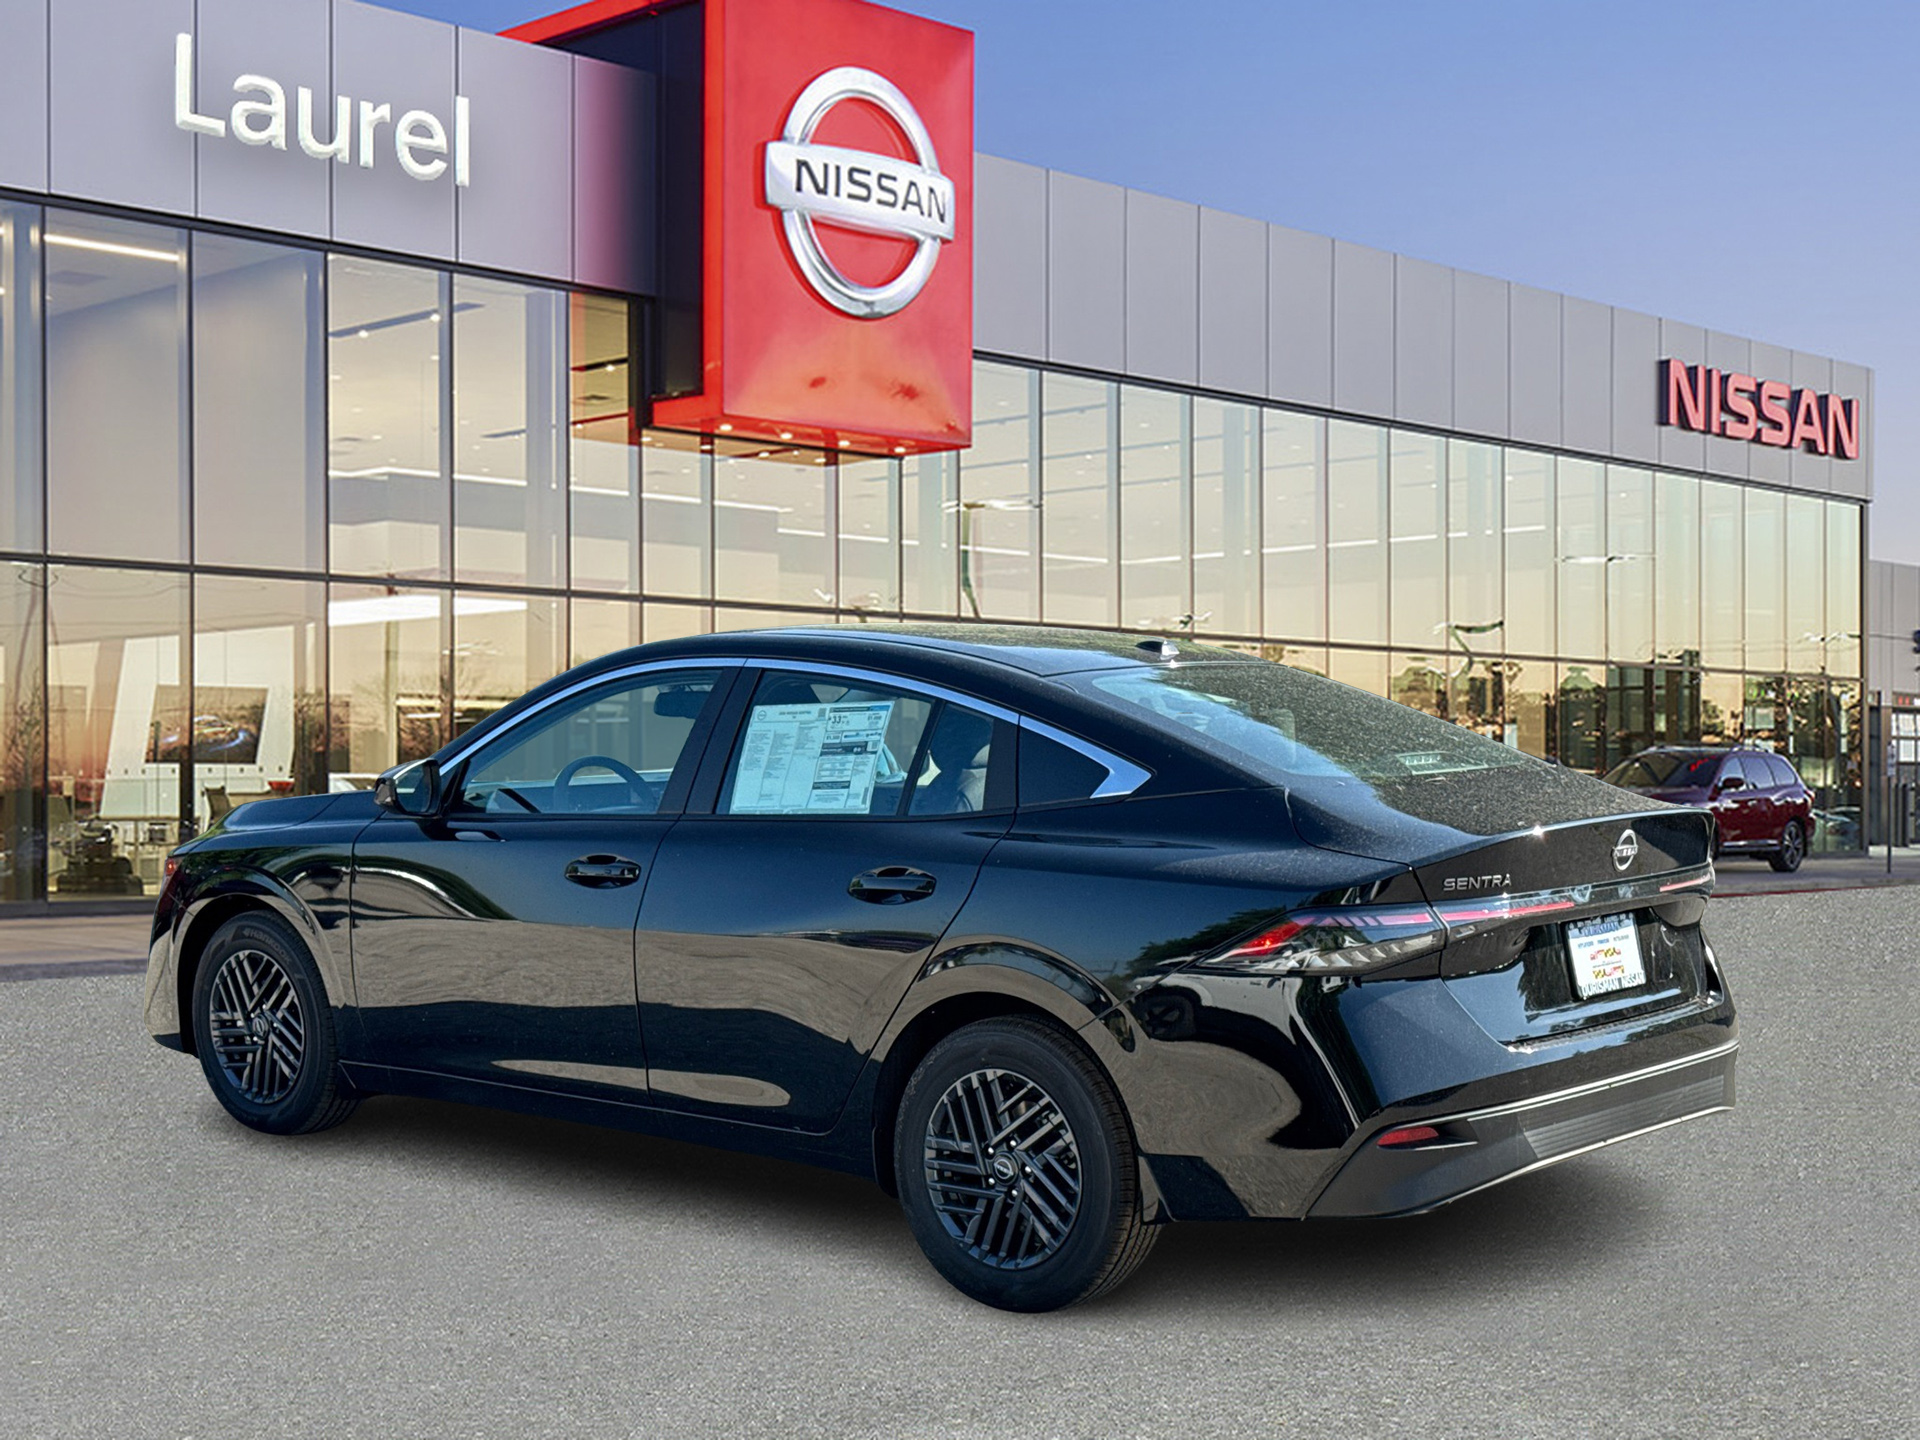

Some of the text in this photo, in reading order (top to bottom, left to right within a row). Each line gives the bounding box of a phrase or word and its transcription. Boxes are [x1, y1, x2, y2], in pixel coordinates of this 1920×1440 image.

[175, 32, 470, 188] Laurel
[795, 158, 947, 224] NISSAN
[1658, 358, 1860, 460] NISSAN
[1443, 873, 1512, 892] SENTRA
